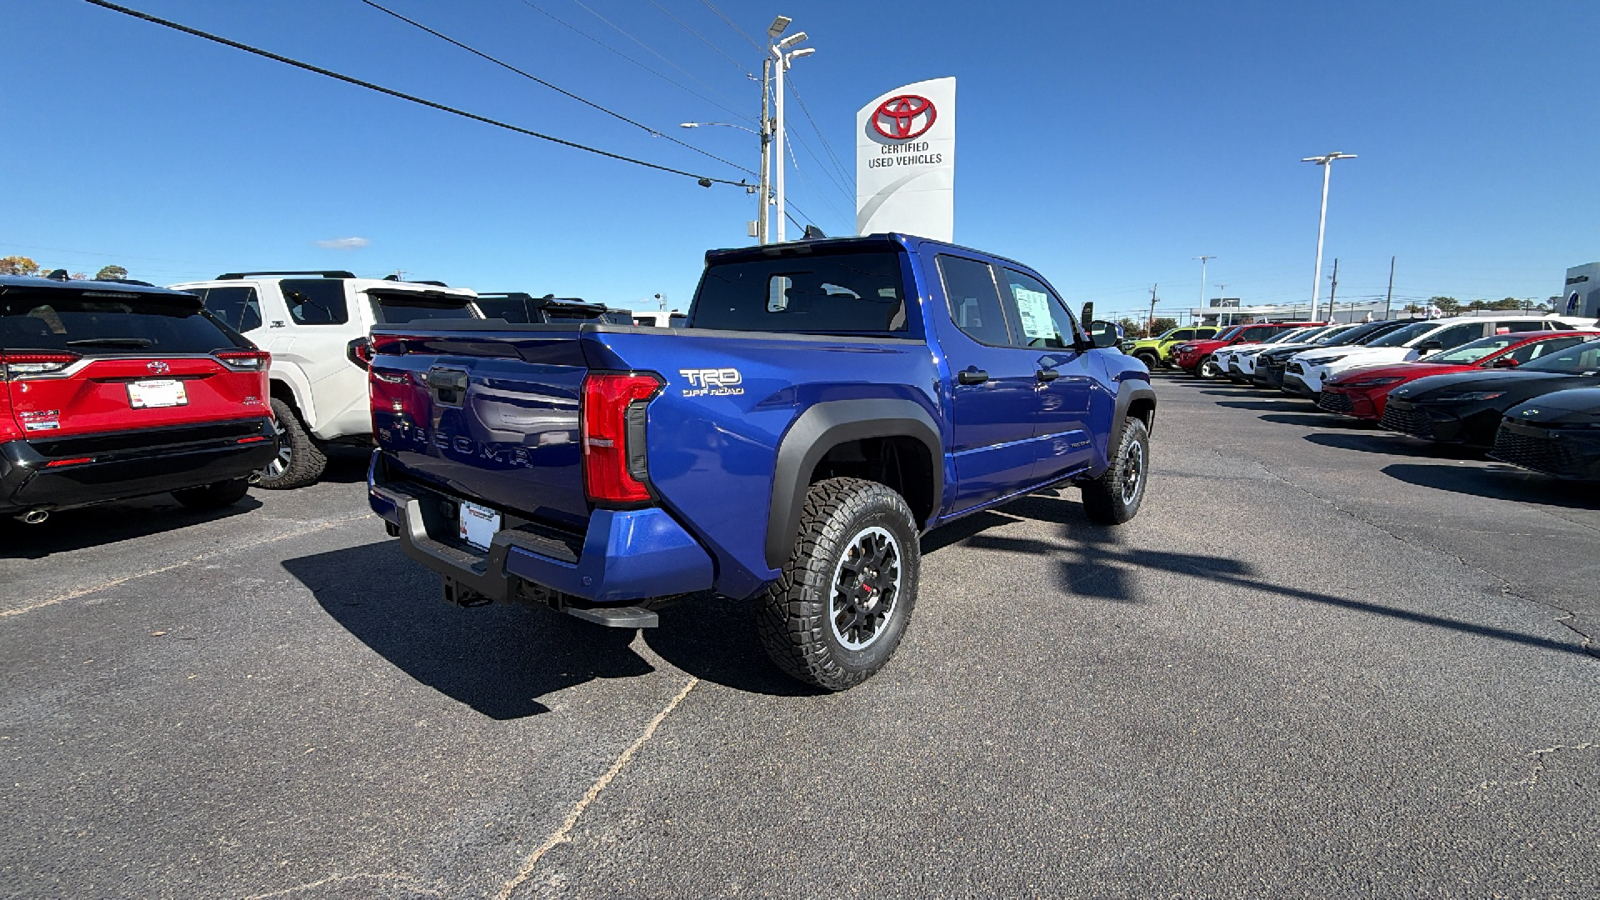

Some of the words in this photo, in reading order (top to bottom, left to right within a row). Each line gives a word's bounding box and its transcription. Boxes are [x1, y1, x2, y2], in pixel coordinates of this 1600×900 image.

[881, 141, 929, 154] CERTIFIED
[868, 157, 894, 169] USED
[896, 153, 942, 166] VEHICLES
[679, 368, 742, 389] TRD
[682, 389, 709, 397] OFF
